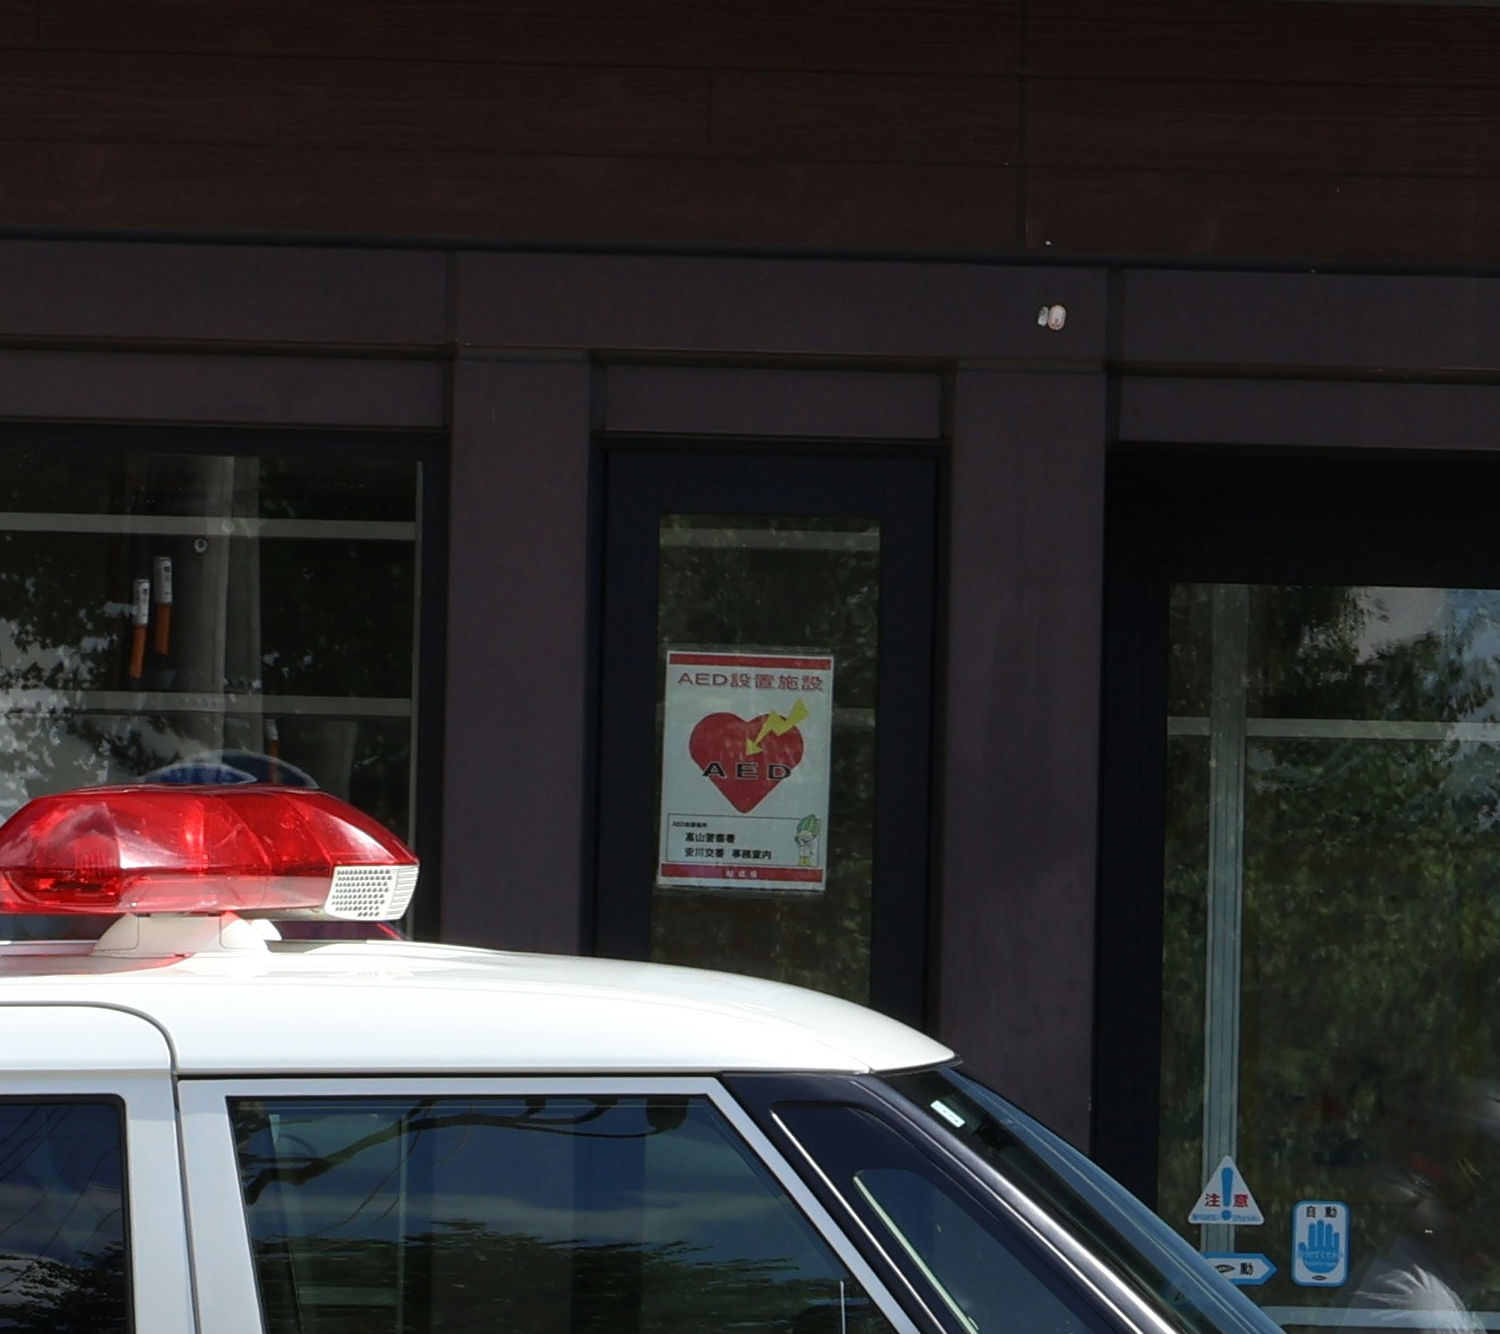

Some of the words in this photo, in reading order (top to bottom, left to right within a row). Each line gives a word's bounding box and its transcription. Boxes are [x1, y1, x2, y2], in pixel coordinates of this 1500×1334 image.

[676, 672, 823, 691] AED設置施設
[702, 762, 792, 780] AED
[685, 832, 736, 844] 高山警察署
[684, 847, 725, 859] 安川交番
[731, 849, 772, 860] 事務室内
[1306, 1205, 1338, 1218] 自動
